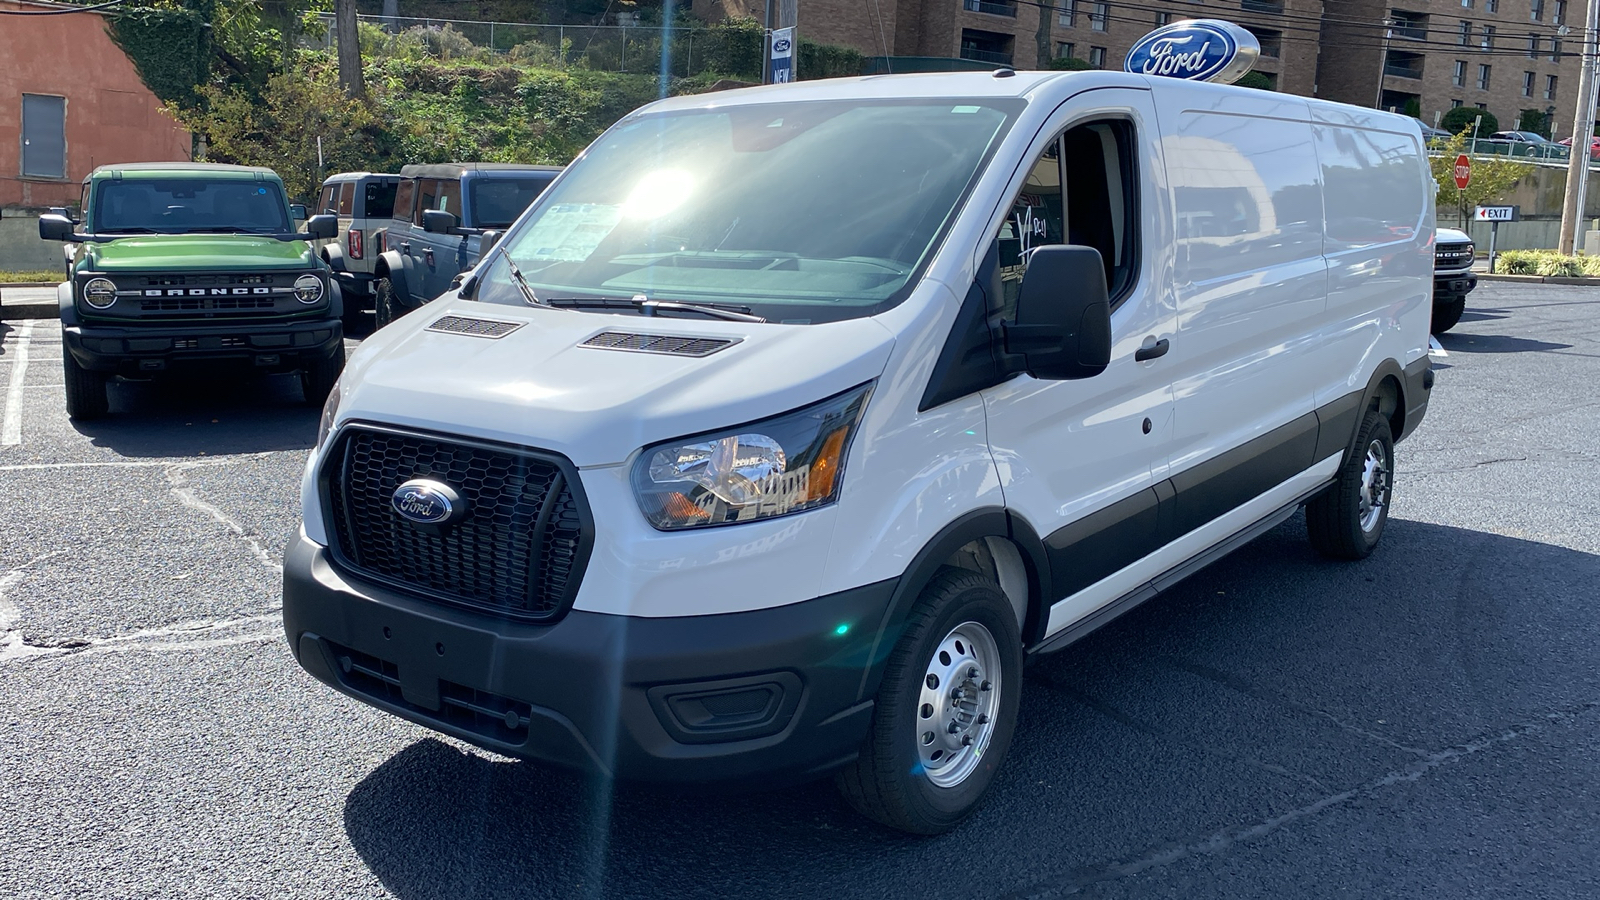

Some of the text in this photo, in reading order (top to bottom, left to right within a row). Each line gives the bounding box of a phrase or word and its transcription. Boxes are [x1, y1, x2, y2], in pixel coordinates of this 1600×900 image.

[1143, 35, 1210, 75] Ford
[774, 68, 790, 84] NEW
[1455, 165, 1469, 179] STOP
[1488, 209, 1508, 218] EXIT
[145, 287, 269, 297] BRONCO
[400, 491, 434, 516] Ford
